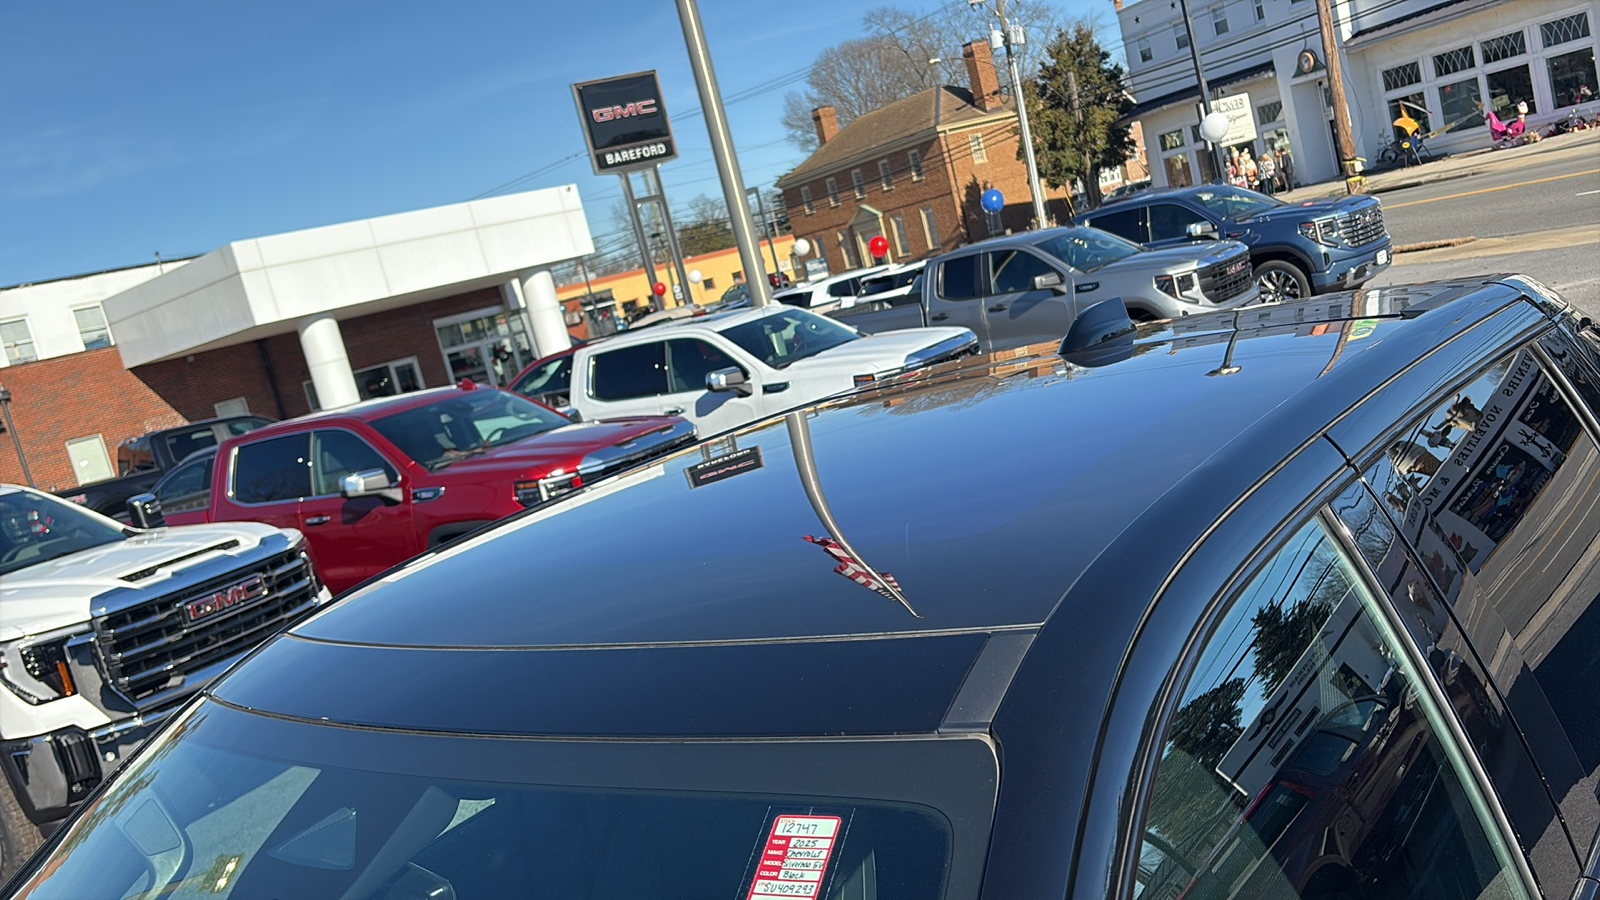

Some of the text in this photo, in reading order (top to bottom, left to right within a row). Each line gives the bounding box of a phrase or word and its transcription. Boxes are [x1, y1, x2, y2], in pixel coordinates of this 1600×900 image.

[593, 99, 657, 122] GMC
[605, 143, 667, 165] BAREFORD
[187, 577, 263, 620] GMC
[782, 823, 817, 835] 12747
[793, 839, 818, 848] 2025
[783, 860, 811, 869] Silverado
[783, 870, 805, 879] Black
